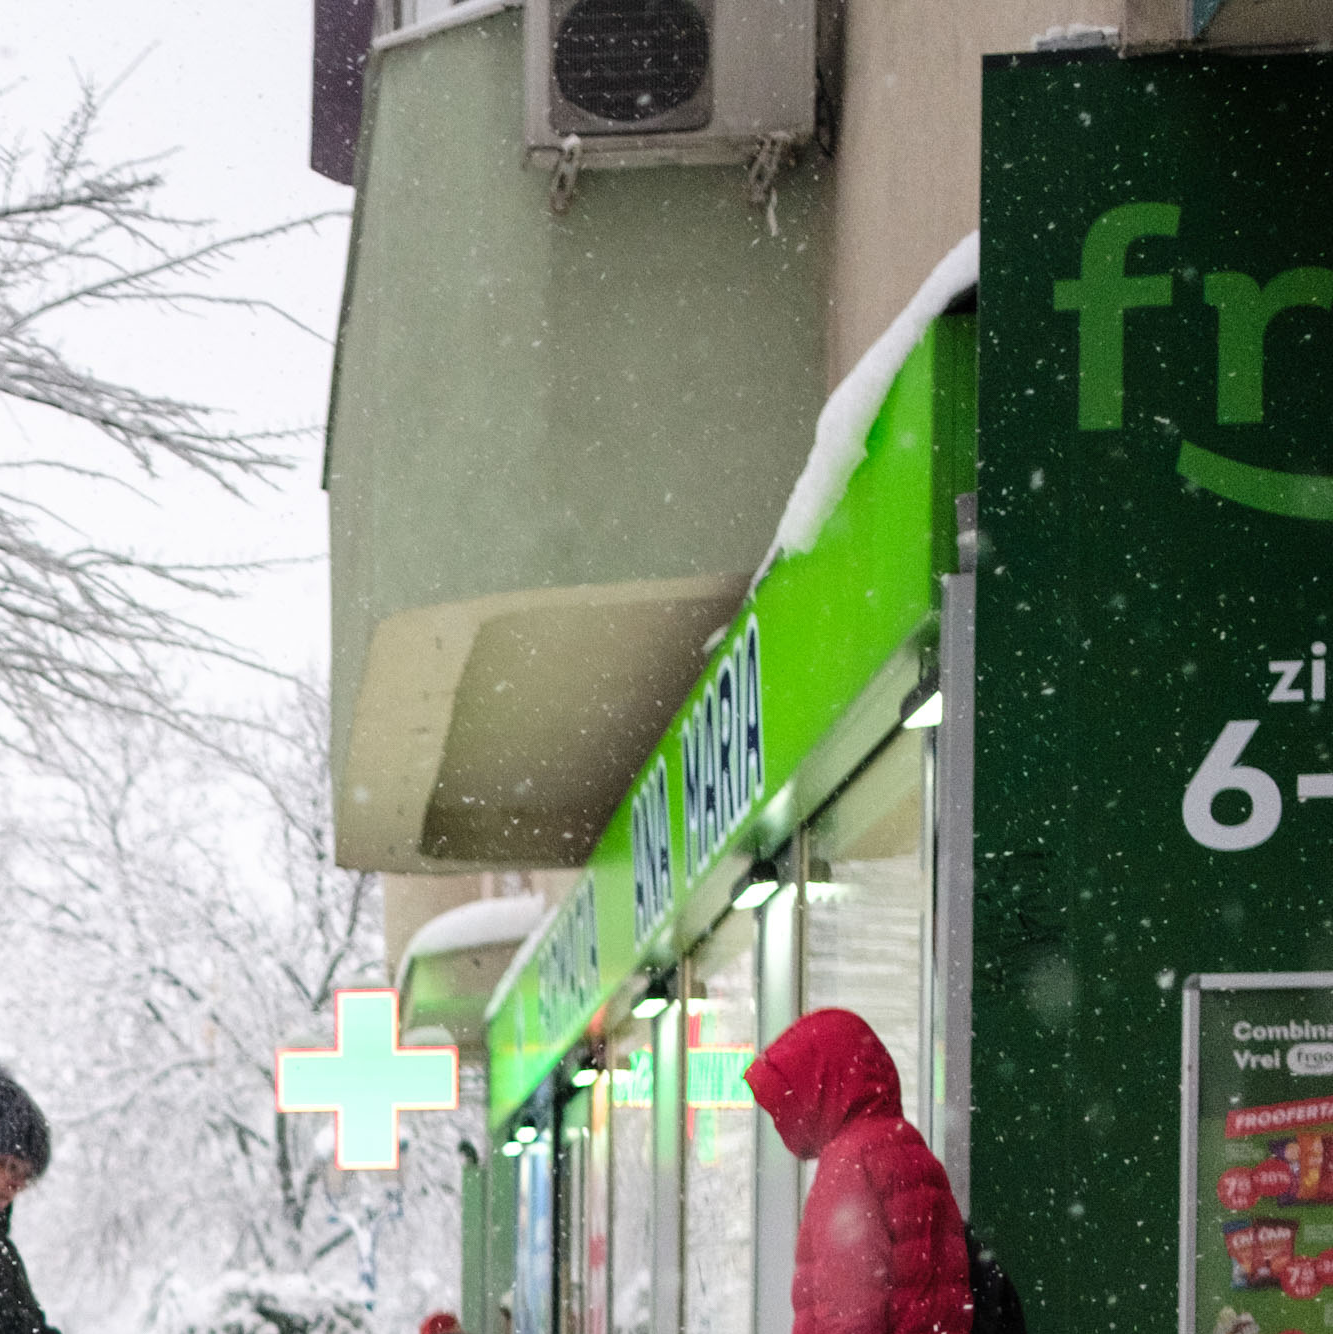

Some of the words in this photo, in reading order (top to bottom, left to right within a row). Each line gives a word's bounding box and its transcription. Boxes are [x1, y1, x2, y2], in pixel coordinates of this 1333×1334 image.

[1268, 642, 1326, 704] zi
[632, 754, 674, 950] ANA
[682, 613, 766, 888] MARIA
